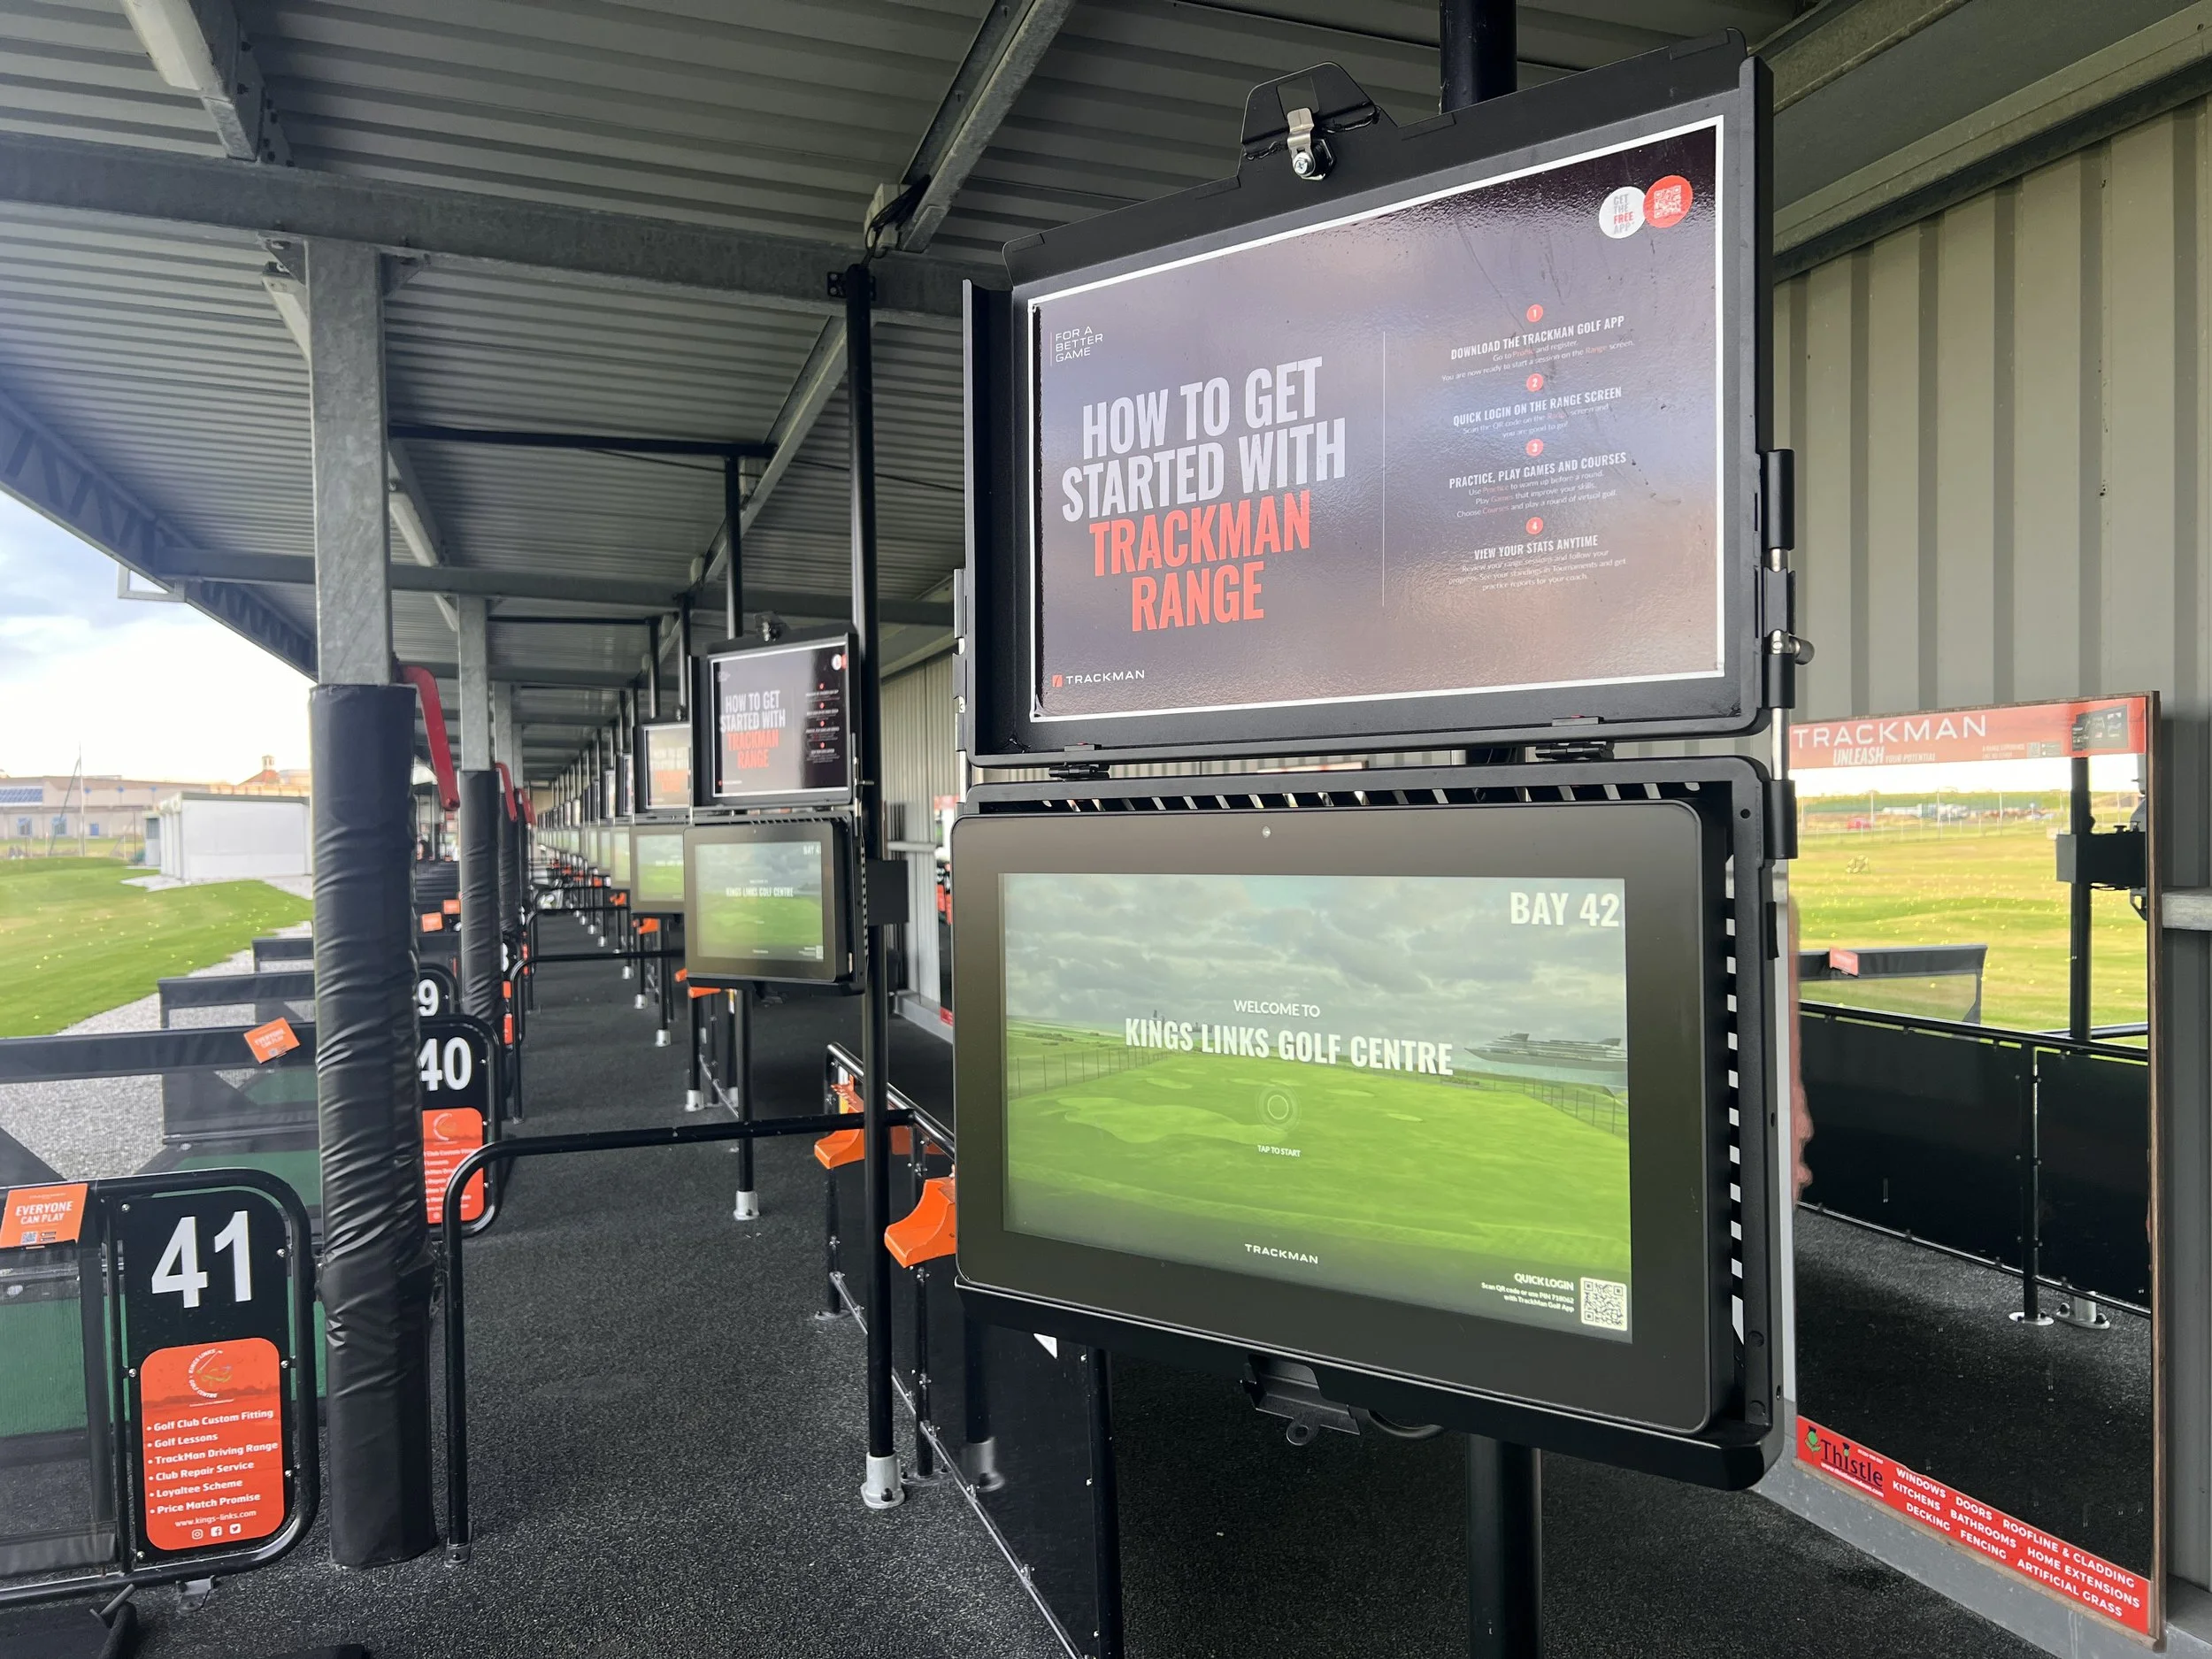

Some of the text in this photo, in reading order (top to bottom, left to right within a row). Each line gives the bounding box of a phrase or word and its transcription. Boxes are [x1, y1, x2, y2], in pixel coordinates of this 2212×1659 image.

[1613, 211, 1634, 224] FREE
[1056, 326, 1093, 342] FOR A
[1056, 333, 1103, 352] BETTER
[1451, 315, 1625, 360] DOWNLOAD THE TRACKMAN GOLF APP
[1056, 346, 1091, 362] GAME
[1483, 365, 1502, 374] ready
[1512, 360, 1527, 369] start
[1585, 345, 1608, 355] Range
[1536, 344, 1549, 353] and
[1082, 356, 1323, 460] HOW TO GET
[1452, 386, 1622, 427] QUICK LOGIN ON THE RANGE SCREEN
[1062, 417, 1346, 522] STARTED WITH
[1449, 452, 1627, 489] PRACTICE, PLAY GAMES AND COURSES
[1456, 510, 1482, 518] Choose
[1482, 506, 1509, 514] Courses
[1510, 502, 1523, 511] and
[1525, 501, 1539, 510] play
[1546, 496, 1567, 506] round
[1578, 491, 1601, 500] virtual
[1089, 489, 1311, 577] TRACKMAN
[1474, 534, 1599, 560] VIEW YOUR STATS ANYTIME
[1131, 561, 1265, 632] RANGE
[1065, 669, 1145, 685] TRACKMAN
[725, 690, 780, 714] HOW TO GET
[721, 708, 786, 733] STARTED WITH
[1793, 714, 1986, 749] TRACKMAN
[727, 728, 779, 751] TRACKMAN
[737, 749, 769, 769] RANGE
[1832, 745, 1885, 767] UNLEASH
[1509, 891, 1620, 927] BAY 42
[1233, 999, 1321, 1018] WELCOME TO
[1125, 1018, 1453, 1076] KINGS LINKS GOLF CENTRE
[419, 1036, 472, 1091] 40
[1257, 1144, 1301, 1157] TAP TO START
[15, 1200, 74, 1217] EVERYONE
[20, 1213, 65, 1225] CAN PLAY
[150, 1210, 254, 1309] 41
[1244, 1243, 1319, 1264] TRACKMAN
[1481, 1282, 1496, 1291] Scan
[1495, 1284, 1506, 1293] QR
[1505, 1287, 1521, 1295] code
[1539, 1292, 1551, 1301] PIN
[1514, 1273, 1575, 1291] QUICK LOGIN
[1517, 1296, 1548, 1308] TrackMan
[1548, 1302, 1562, 1310] Golf
[1561, 1304, 1575, 1313] App
[153, 1409, 274, 1432] Golf Club Custom Fitting
[154, 1433, 219, 1448] Golf Lessons
[154, 1442, 279, 1465] TrackMan Driving Range
[1820, 1439, 1883, 1487] Thistle
[155, 1461, 254, 1481] Club Repair Service
[156, 1479, 243, 1498] Loyaltee Scheme
[157, 1493, 261, 1514] Price Match Promise
[175, 1510, 257, 1527] www.kings-links.com
[1896, 1467, 2135, 1589] WINDOWS DOORS ROOFLINE & CLADDING
[1892, 1480, 2140, 1609] KITCHENS BATHROOMS HOME EXTENSIONS
[1906, 1502, 2123, 1617] DECKING FENCING ARTIFICIAL GRASS
